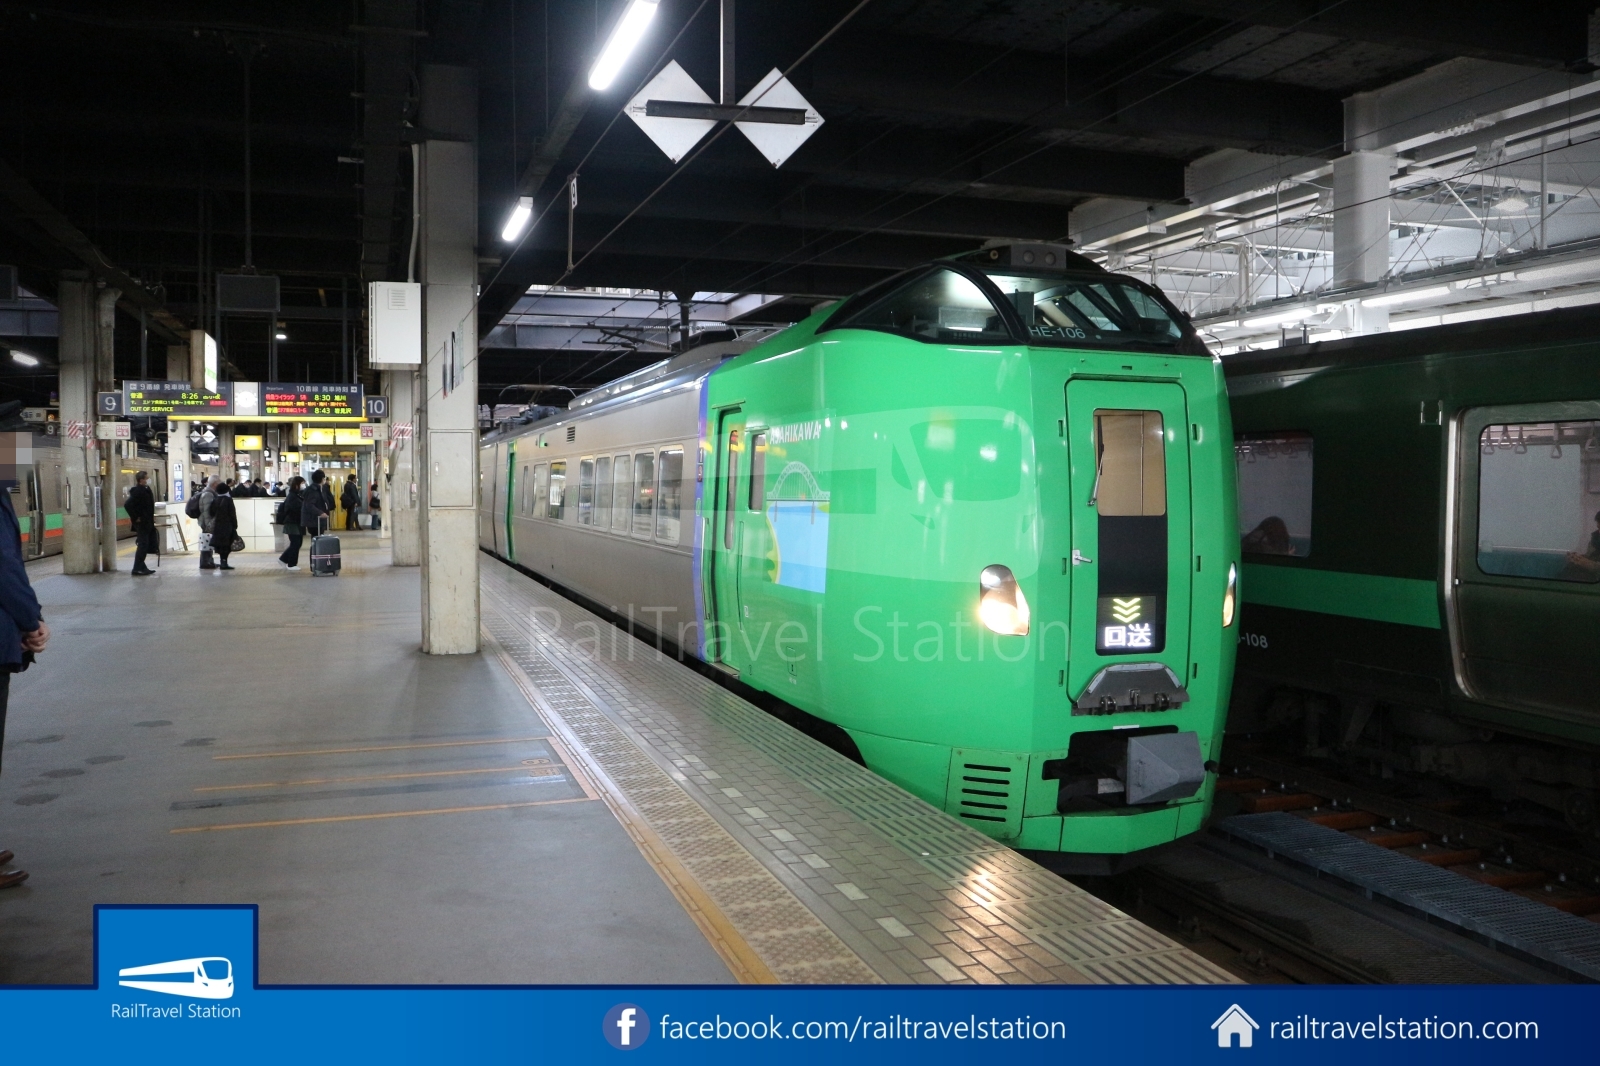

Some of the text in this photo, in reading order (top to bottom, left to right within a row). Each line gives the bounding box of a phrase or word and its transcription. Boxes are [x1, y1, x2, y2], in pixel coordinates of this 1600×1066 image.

[1027, 326, 1086, 339] HE-106
[105, 396, 116, 411] 9
[181, 392, 199, 400] 8:26
[367, 399, 385, 414] 10
[47, 425, 54, 435] 9
[769, 421, 820, 445] ASAHIKAWA
[1104, 622, 1152, 647] 回送
[1238, 632, 1269, 649] -108
